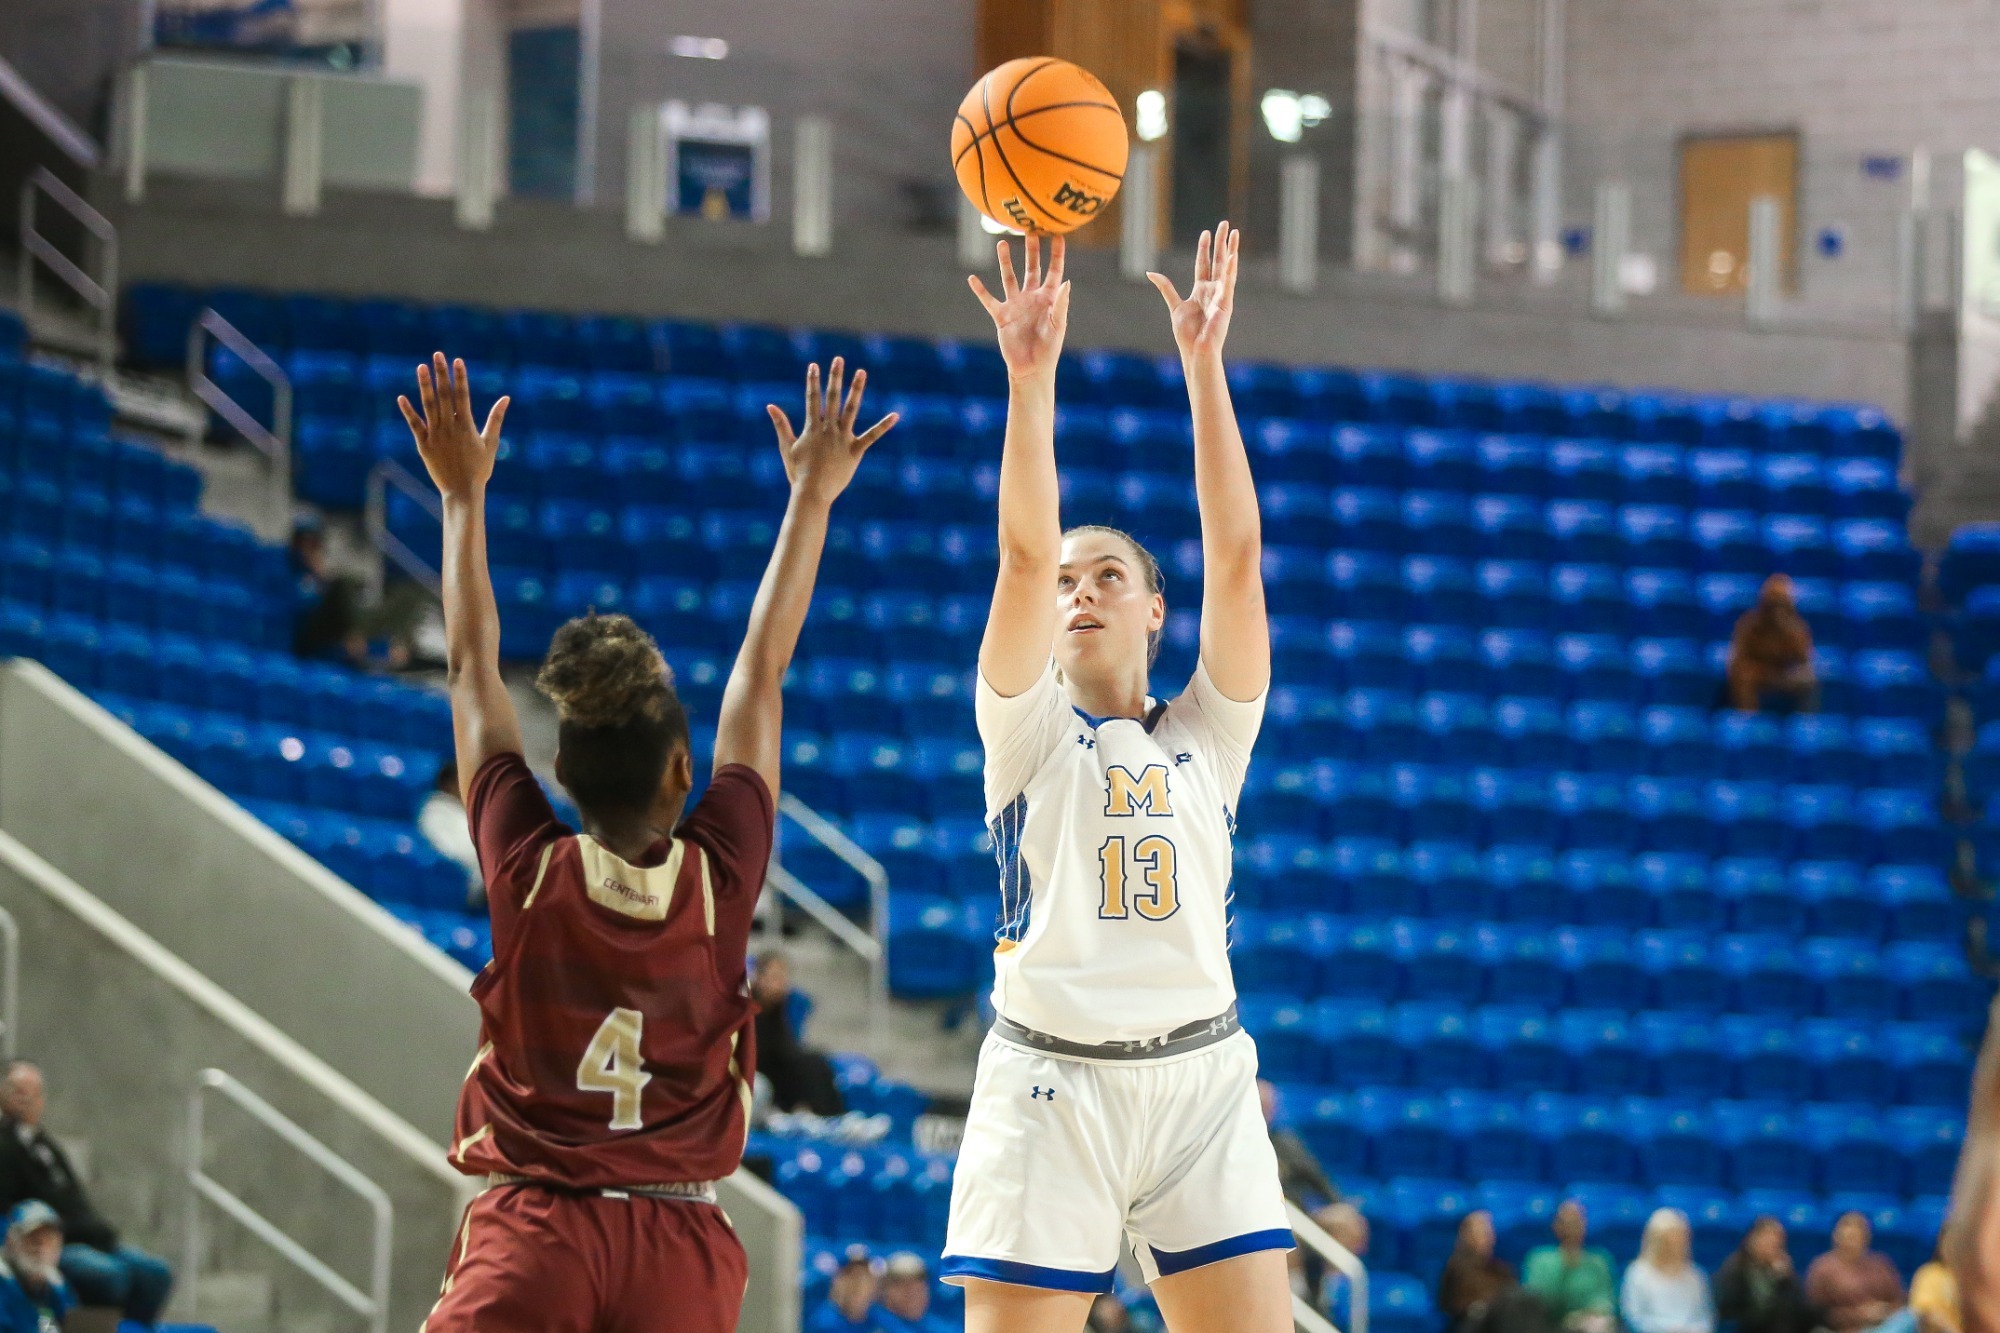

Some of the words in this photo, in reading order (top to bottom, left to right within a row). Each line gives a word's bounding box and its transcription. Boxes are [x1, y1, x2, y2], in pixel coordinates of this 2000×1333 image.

[1104, 763, 1174, 817] M
[1098, 834, 1181, 922] 13
[577, 1006, 652, 1130] 4
